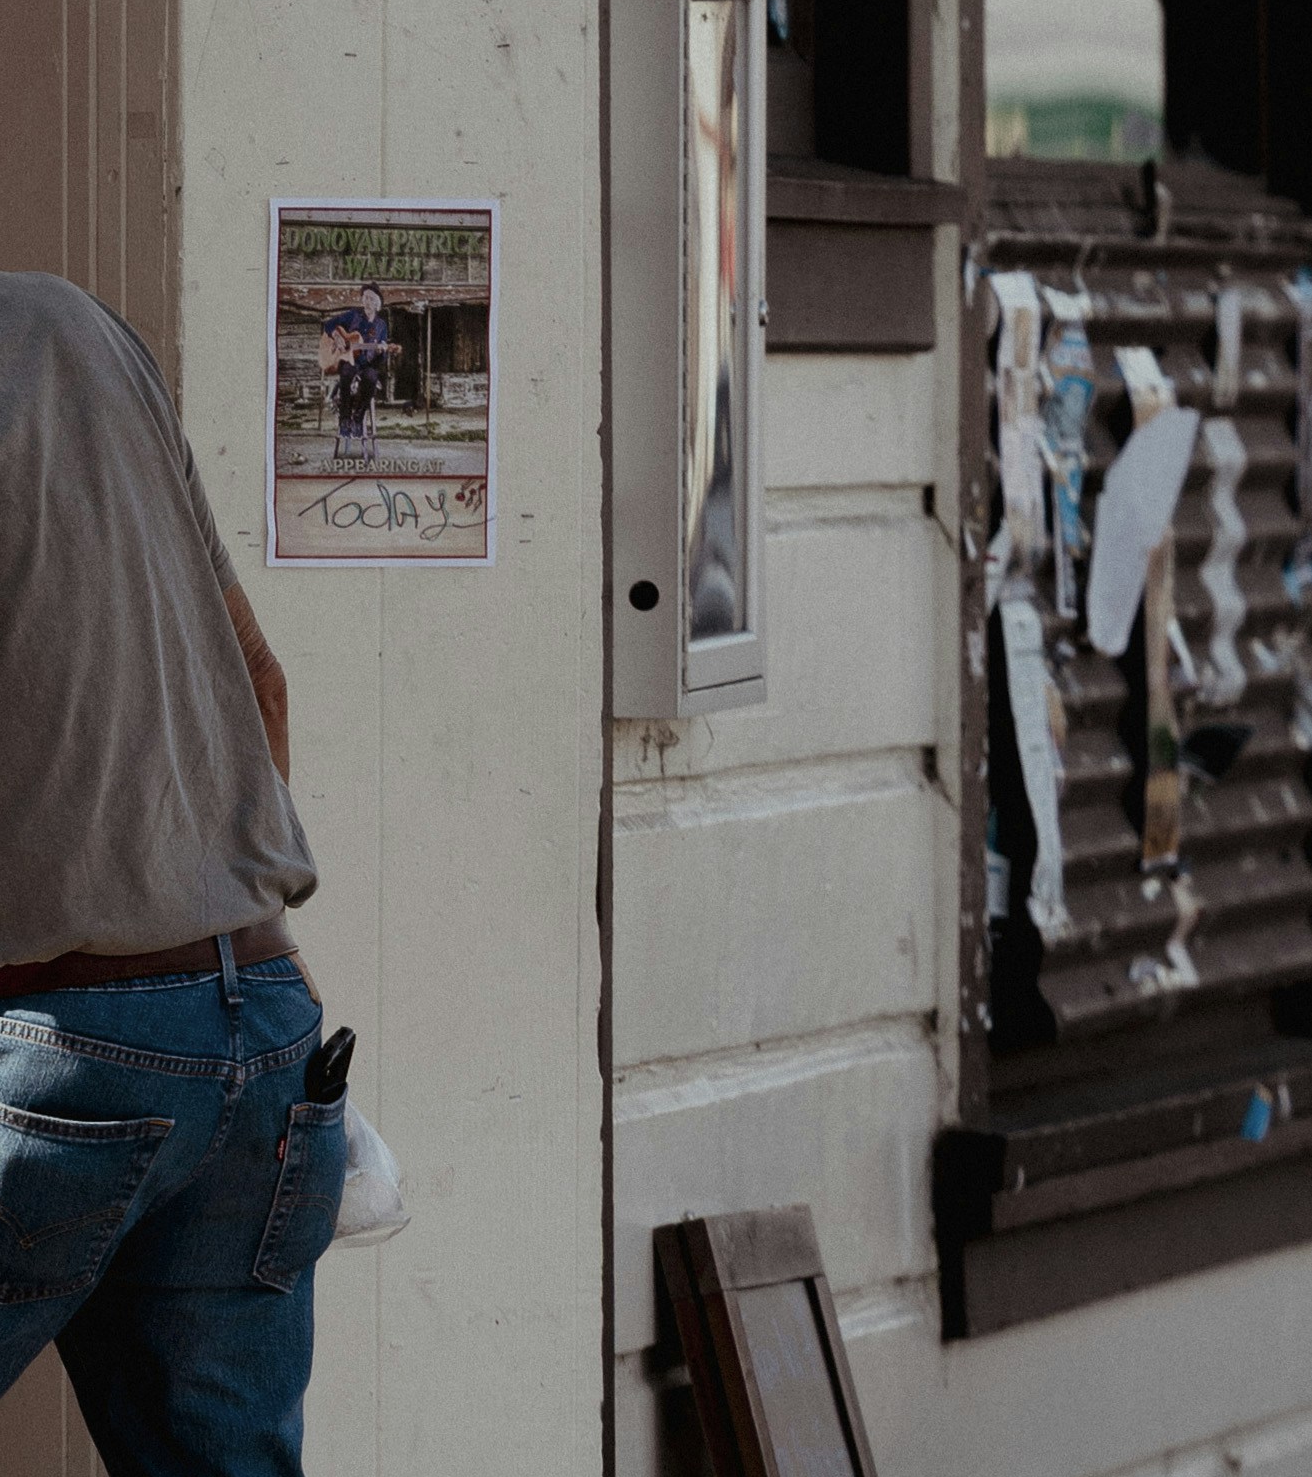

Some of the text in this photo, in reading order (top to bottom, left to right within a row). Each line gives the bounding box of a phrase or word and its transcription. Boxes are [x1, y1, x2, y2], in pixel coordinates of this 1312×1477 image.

[286, 228, 483, 254] DONOVAN PATRICK
[345, 255, 423, 281] WALSH
[320, 459, 445, 474] APPEARING AT
